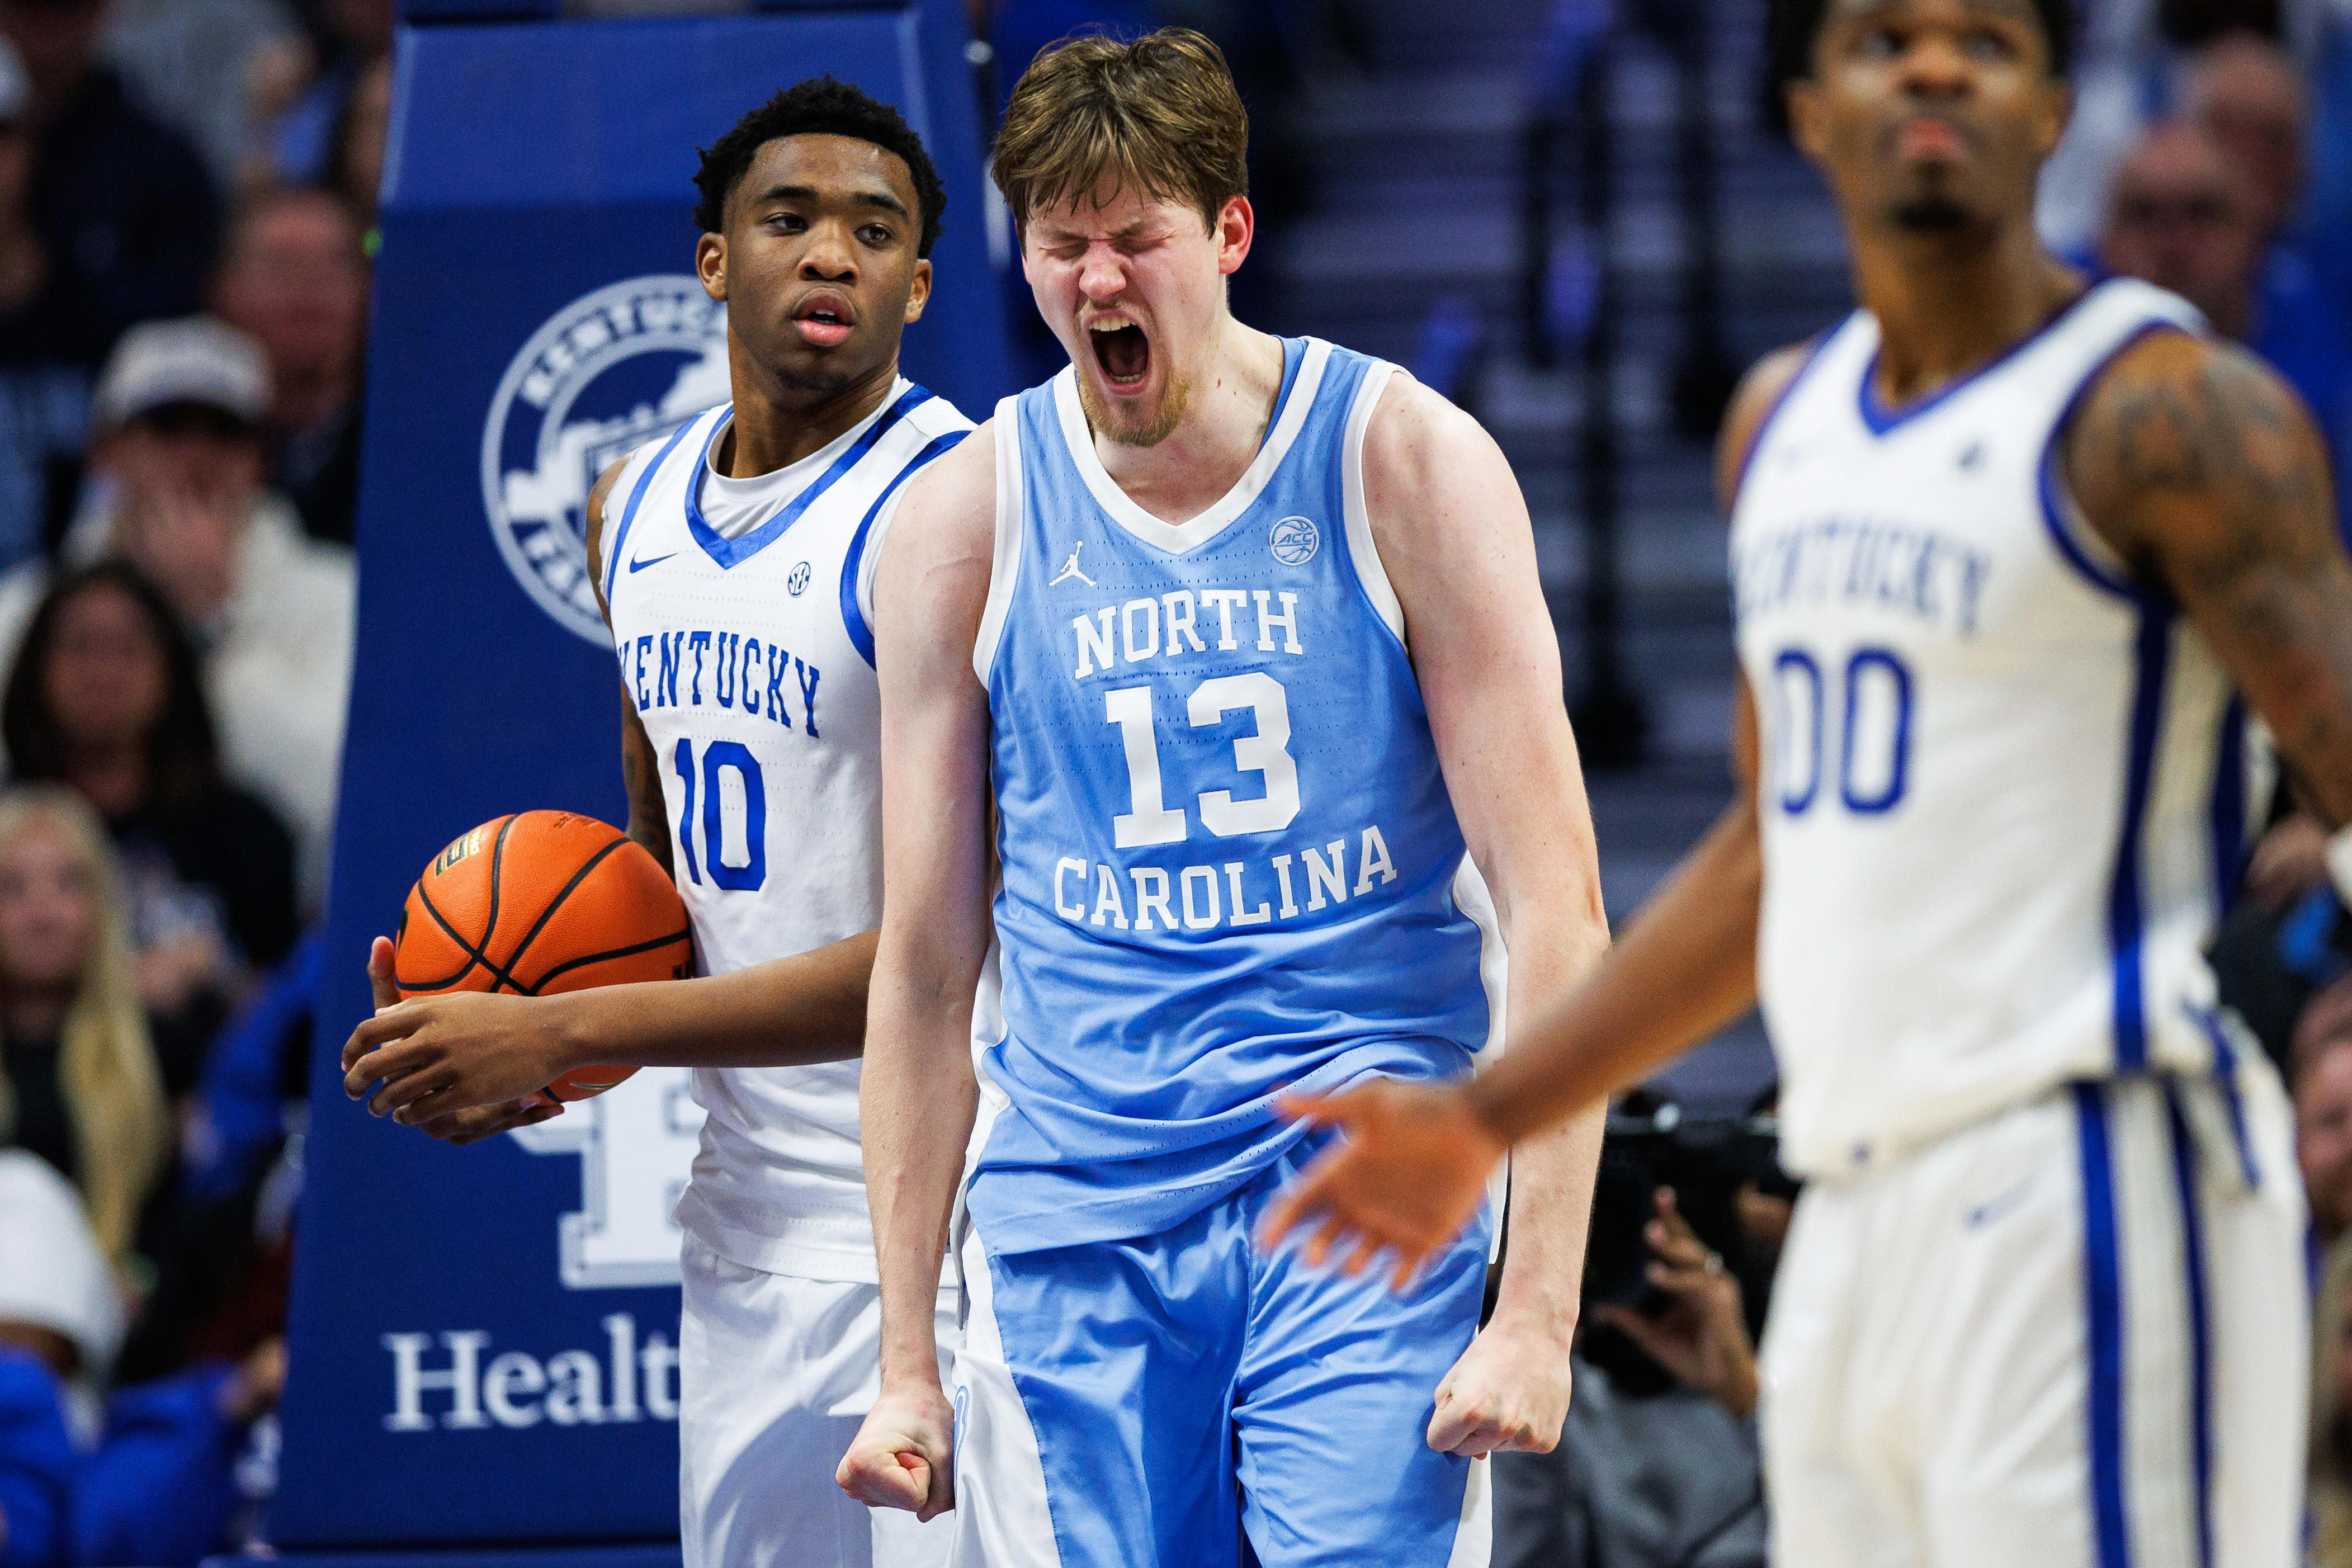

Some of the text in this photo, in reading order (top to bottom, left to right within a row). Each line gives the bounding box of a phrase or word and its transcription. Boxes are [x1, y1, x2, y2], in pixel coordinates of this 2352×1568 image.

[788, 563, 810, 596] SEC
[1073, 589, 1303, 679] NORTH
[1105, 672, 1301, 849] 13
[1775, 646, 1915, 815] 00
[674, 738, 767, 892] 10
[1054, 825, 1397, 931] CAROLINA
